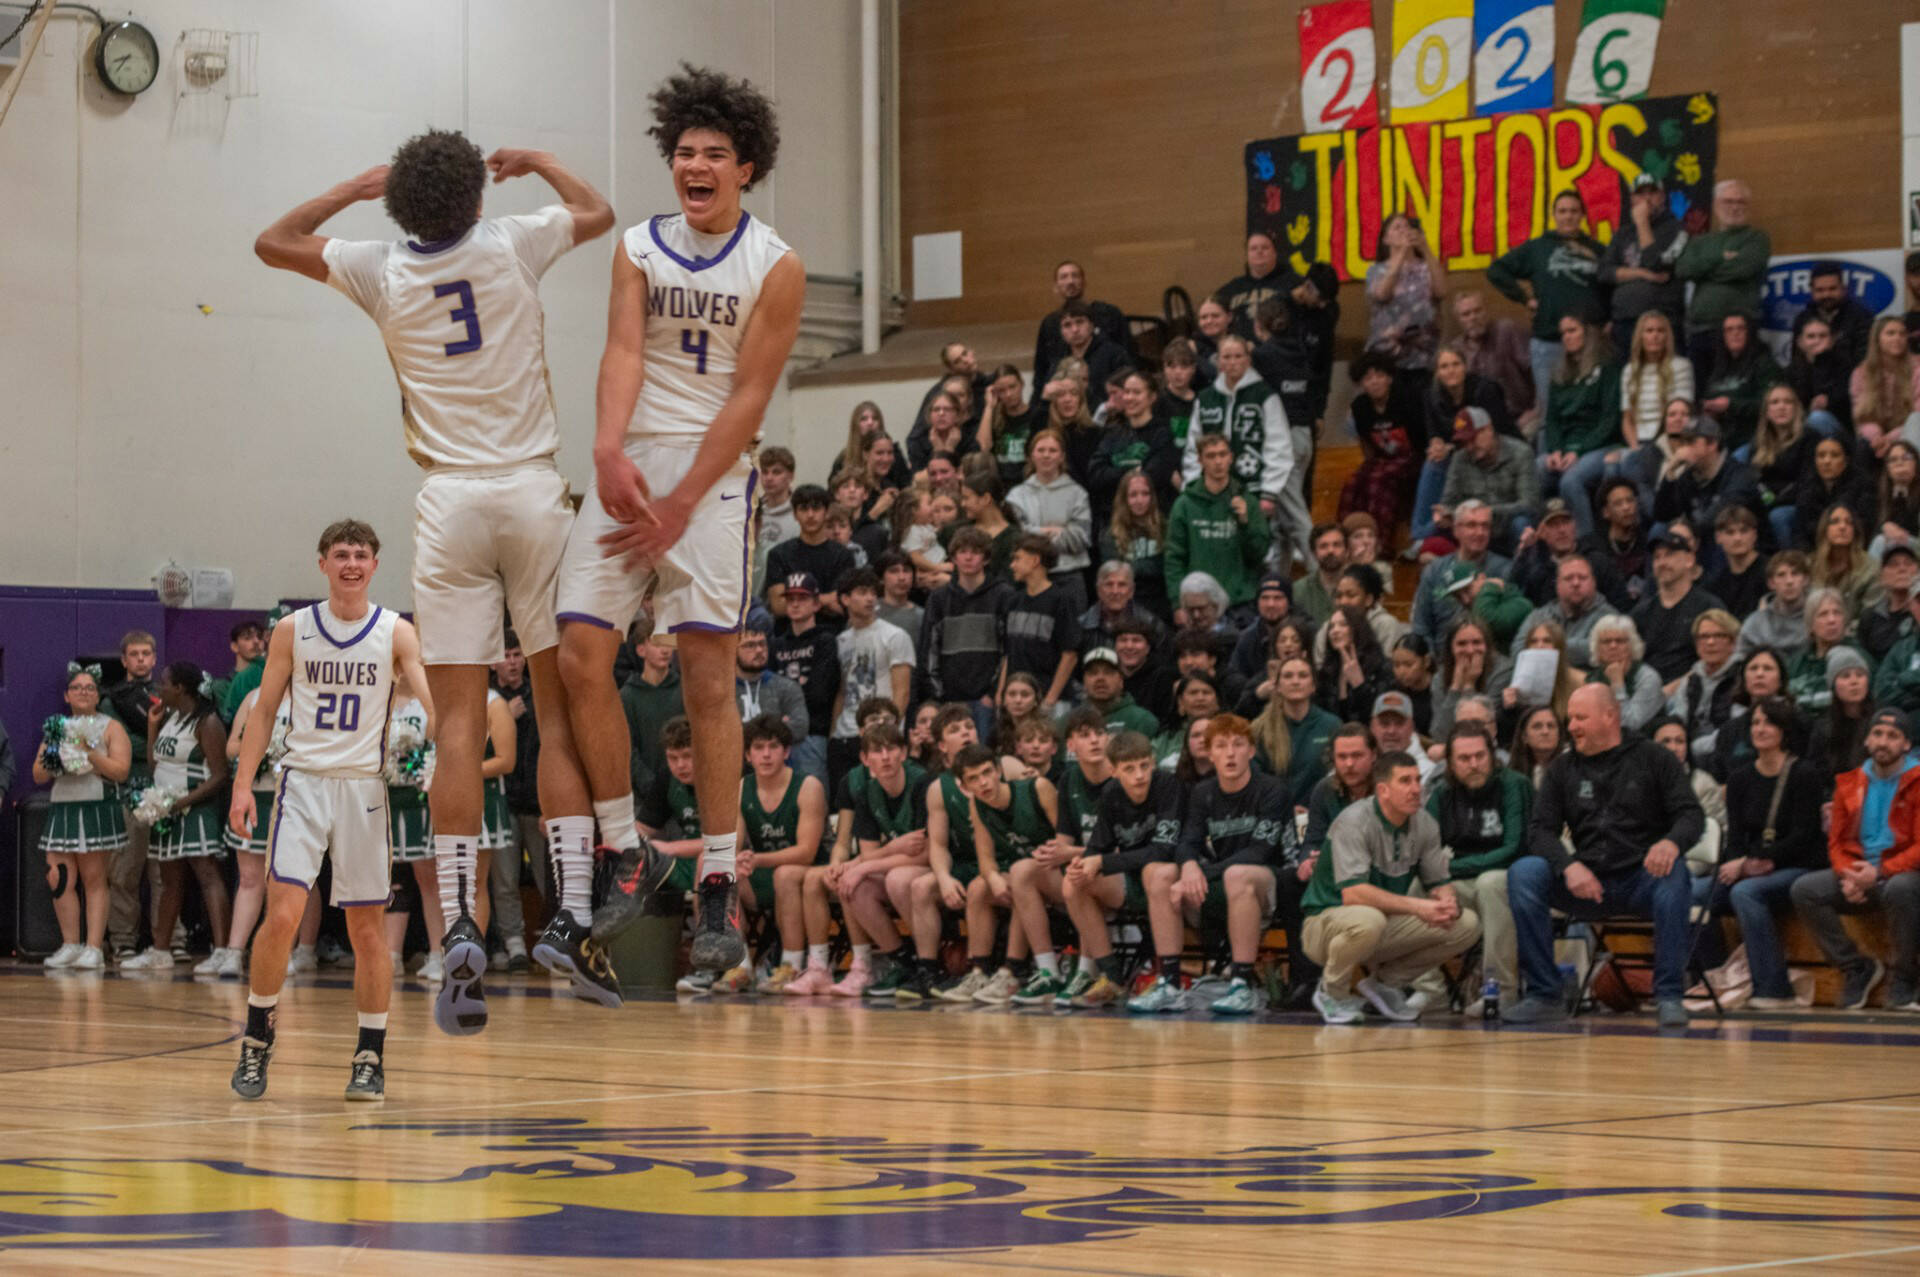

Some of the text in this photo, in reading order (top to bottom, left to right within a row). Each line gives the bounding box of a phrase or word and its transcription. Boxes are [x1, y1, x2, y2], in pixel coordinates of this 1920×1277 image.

[1289, 103, 1648, 281] JUNIORS
[433, 280, 483, 356] 3
[648, 286, 739, 327] WOLVES
[681, 329, 709, 375] 4
[787, 573, 806, 588] W
[305, 660, 377, 686] WOLVES
[315, 692, 360, 732] 20
